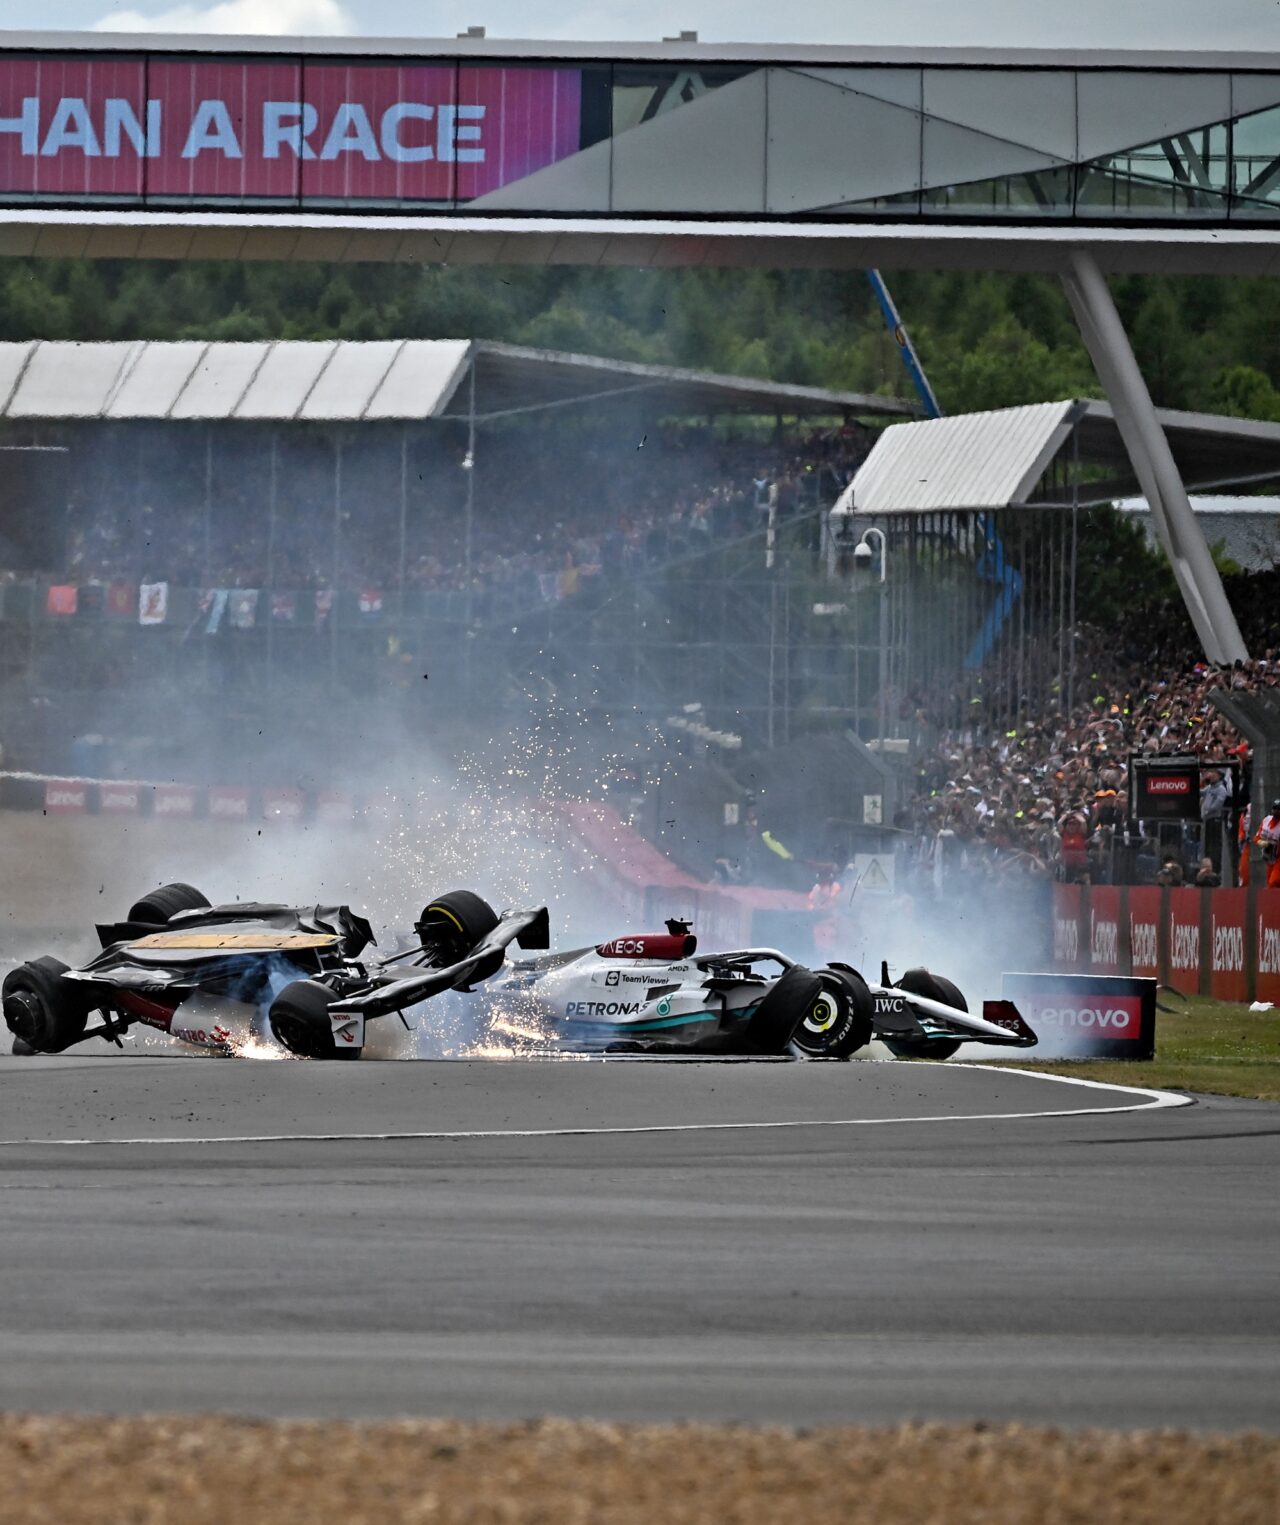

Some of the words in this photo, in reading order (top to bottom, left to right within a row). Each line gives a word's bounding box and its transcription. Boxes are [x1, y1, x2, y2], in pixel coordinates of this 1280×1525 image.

[181, 100, 243, 159] A
[262, 102, 486, 163] RACE
[1150, 780, 1187, 790] Lenovo
[602, 940, 644, 954] INEOS
[1212, 913, 1244, 971] Lenovo
[566, 1002, 650, 1016] PETRONAS
[875, 999, 903, 1013] IWC
[1026, 1003, 1129, 1027] Lenovo
